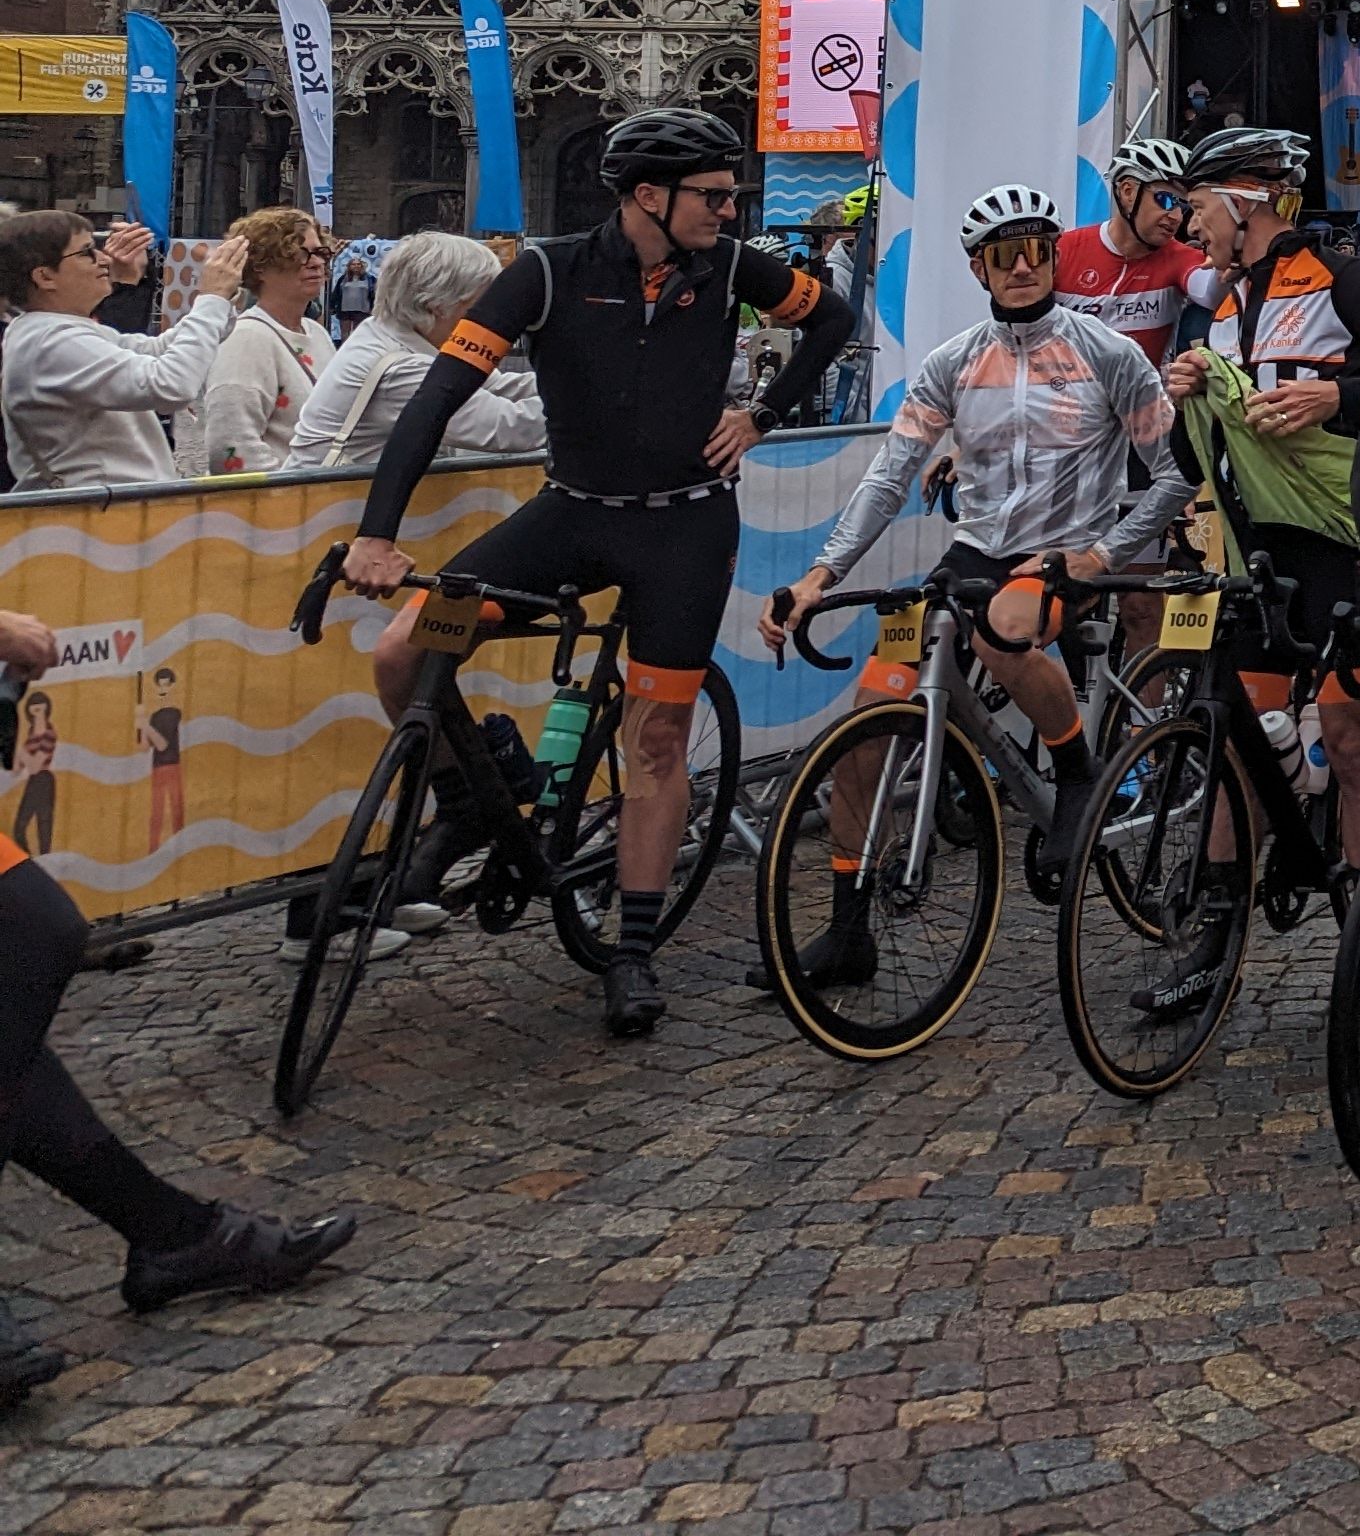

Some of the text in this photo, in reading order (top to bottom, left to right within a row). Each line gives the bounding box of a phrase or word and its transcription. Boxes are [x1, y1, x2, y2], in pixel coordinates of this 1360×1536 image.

[62, 52, 127, 66] RUILPUNT
[40, 64, 127, 77] FIETSMATERI
[1115, 301, 1160, 316] TEAM
[422, 618, 466, 636] 1000
[1170, 612, 1209, 628] 1000
[884, 627, 916, 642] 1000
[60, 640, 110, 667] AAN
